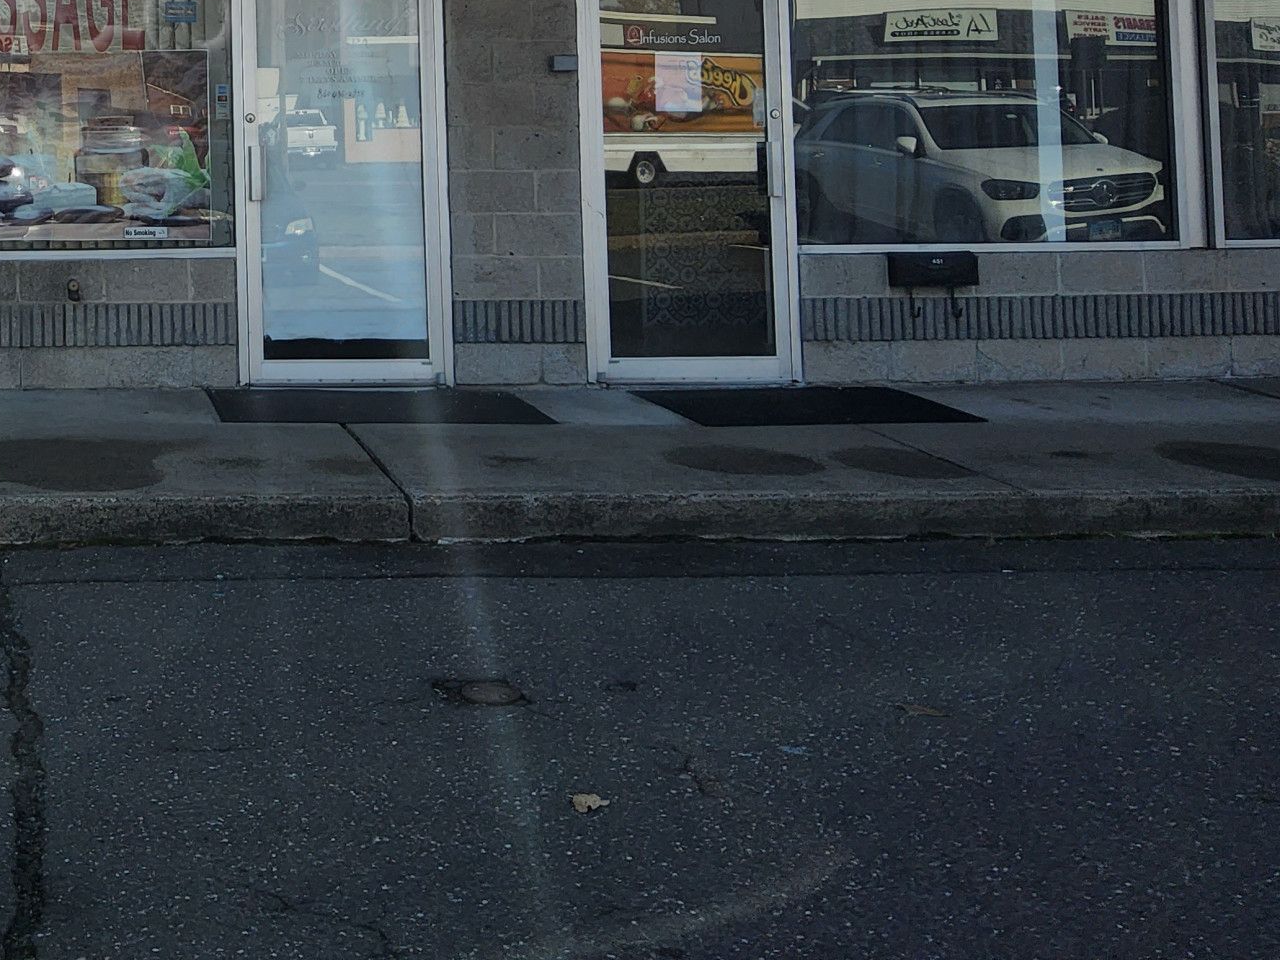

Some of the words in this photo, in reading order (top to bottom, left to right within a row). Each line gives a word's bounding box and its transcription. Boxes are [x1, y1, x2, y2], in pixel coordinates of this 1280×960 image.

[639, 29, 687, 44] Infusions
[688, 28, 721, 45] Salon
[134, 229, 157, 237] Smoking
